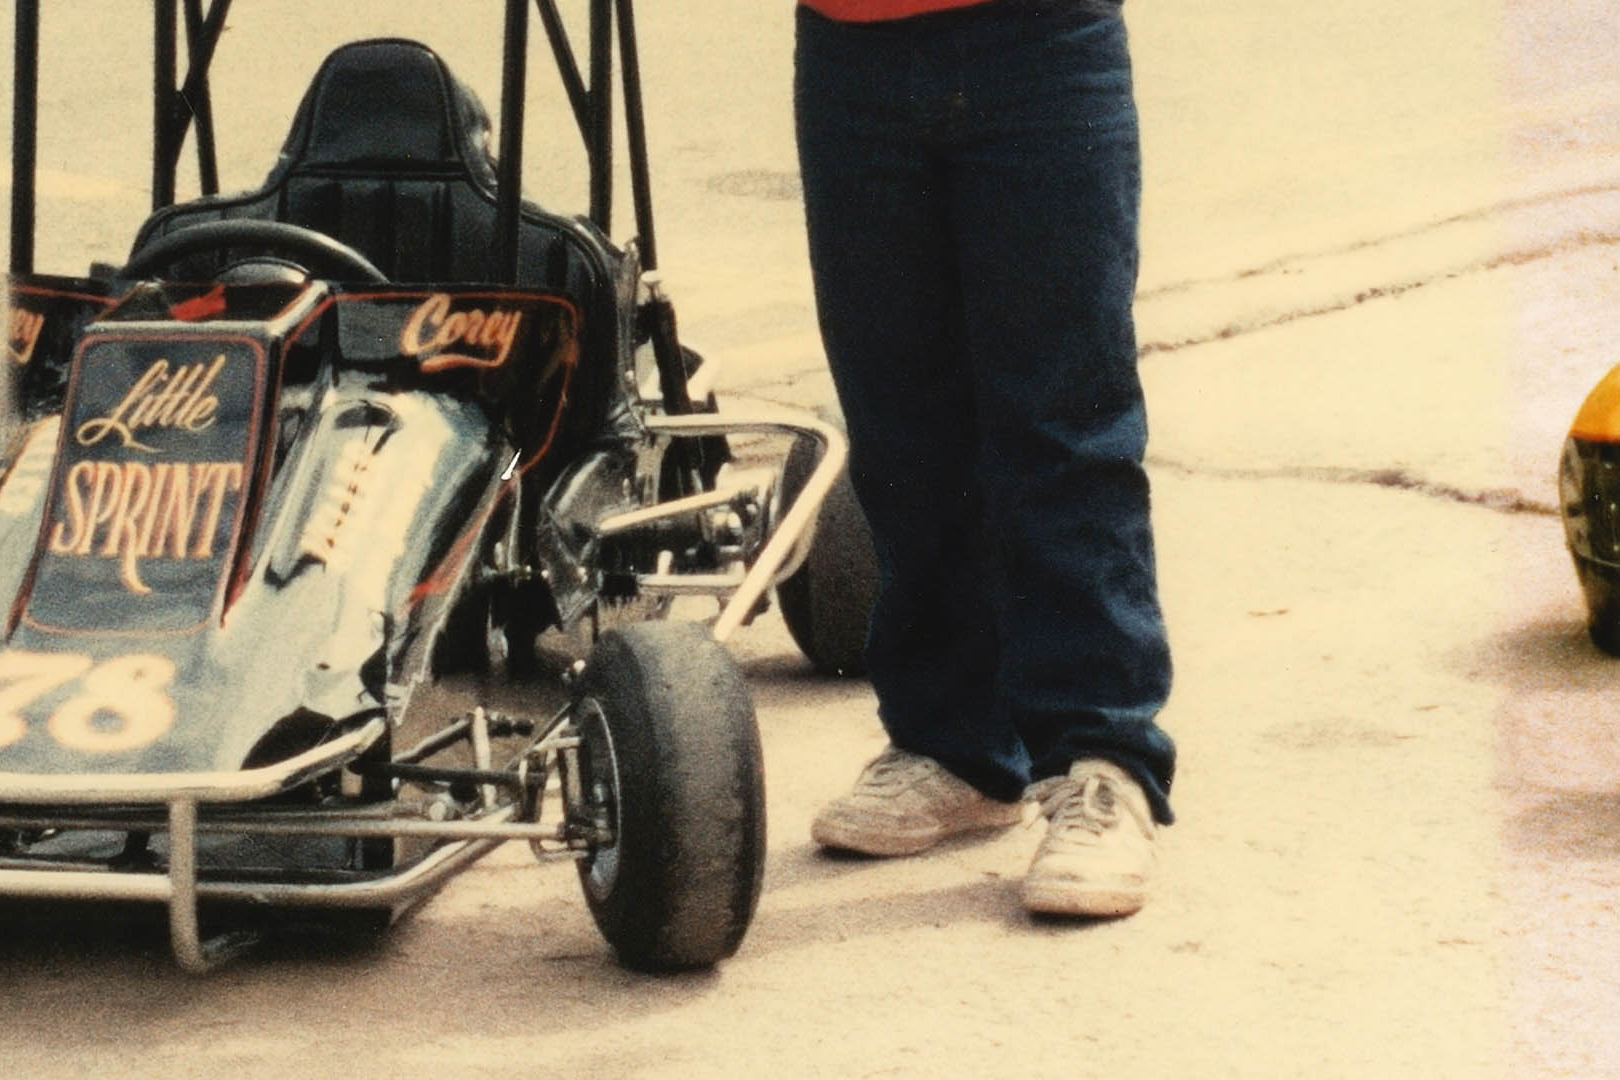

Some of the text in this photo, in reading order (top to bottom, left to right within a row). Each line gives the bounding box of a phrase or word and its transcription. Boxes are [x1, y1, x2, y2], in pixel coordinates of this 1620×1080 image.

[401, 293, 522, 373] Corey
[76, 354, 227, 453] Little
[48, 460, 244, 595] SPRINT
